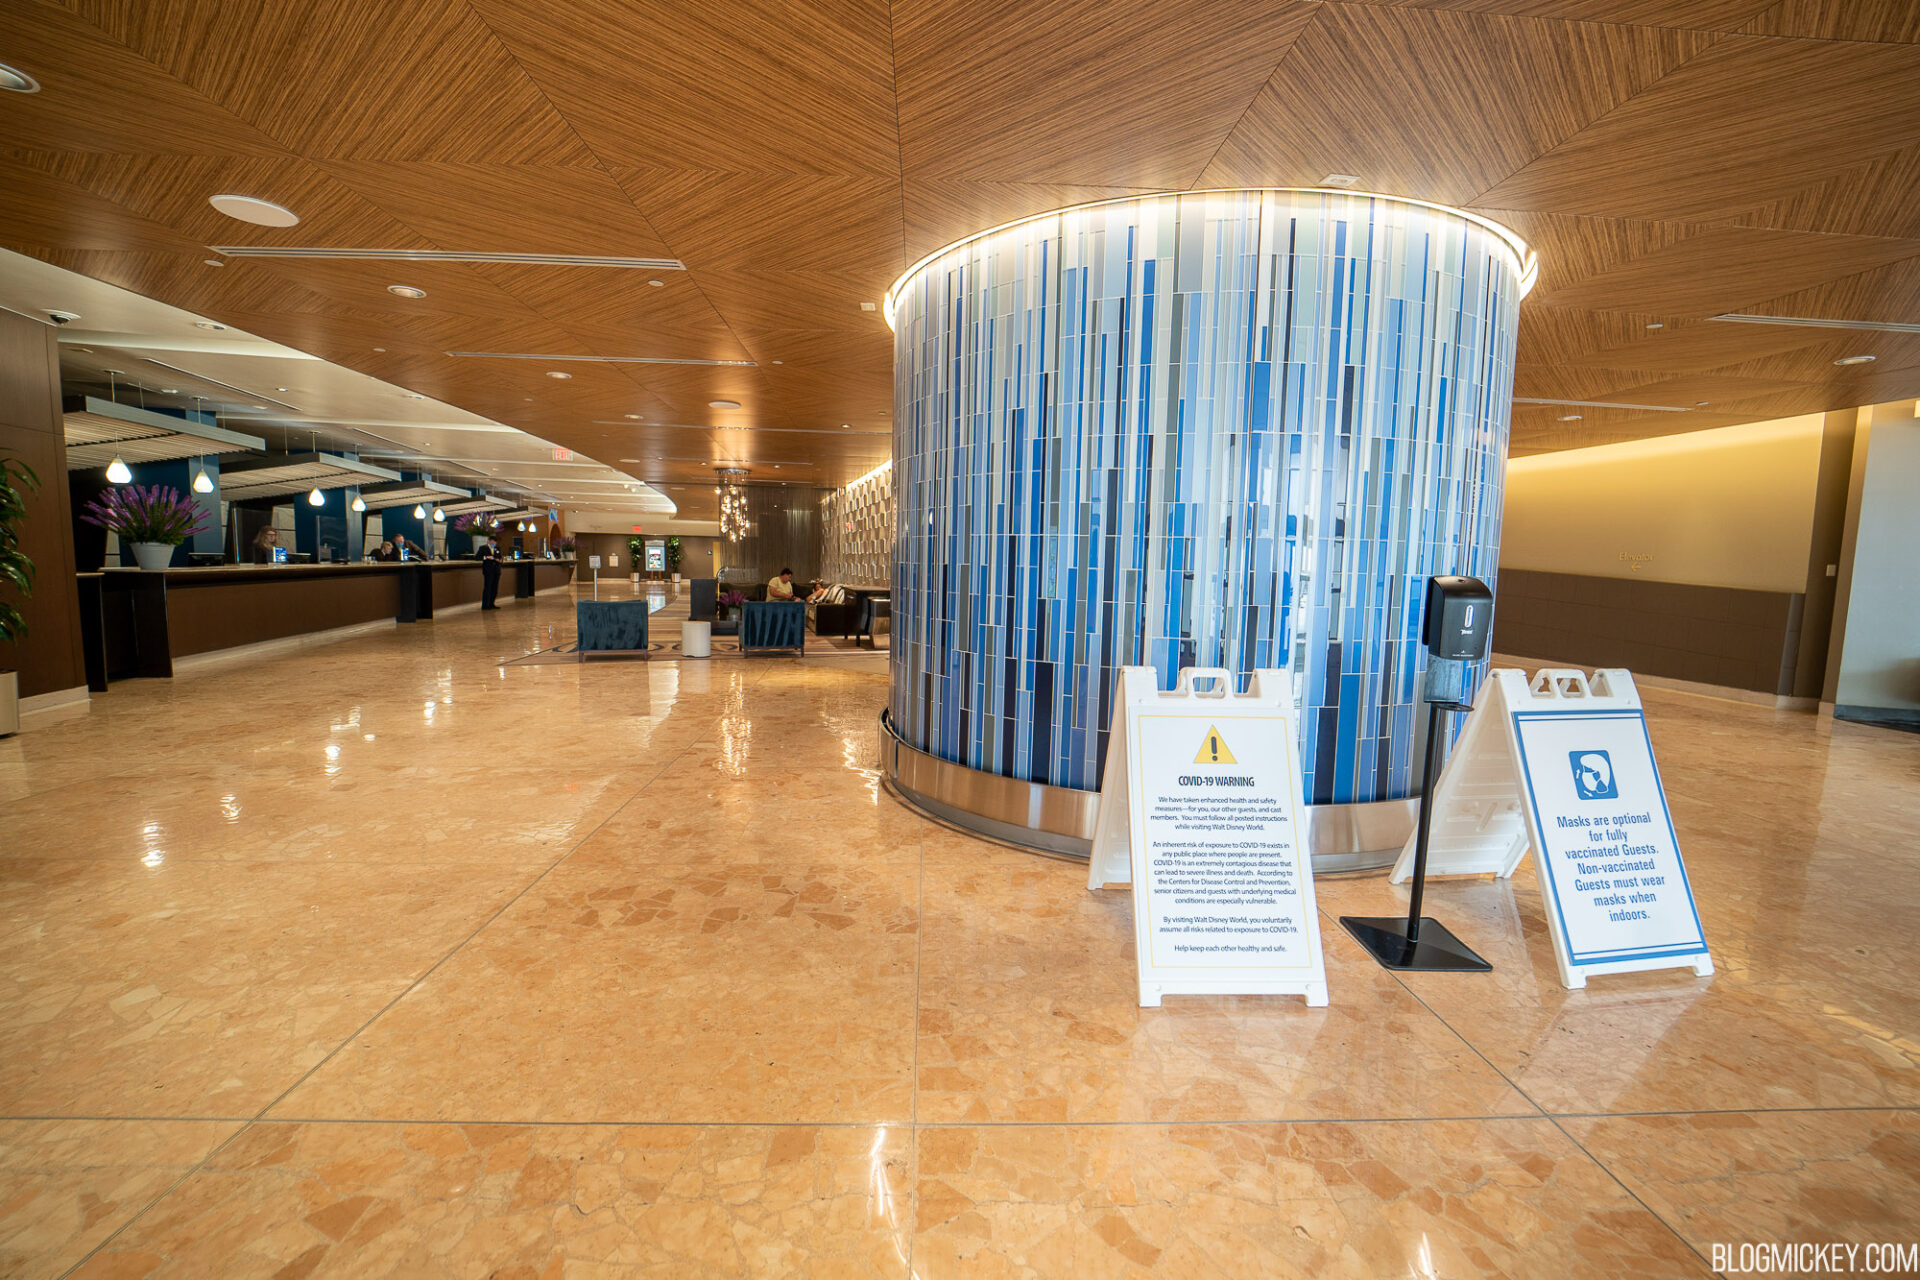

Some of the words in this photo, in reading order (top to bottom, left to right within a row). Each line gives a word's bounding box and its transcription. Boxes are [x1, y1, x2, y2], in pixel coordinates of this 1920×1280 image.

[1178, 776, 1214, 786] COVID-19
[1215, 776, 1255, 787] WARNING
[1557, 816, 1591, 828] Masks
[1594, 817, 1610, 826] are
[1612, 812, 1652, 827] optional
[1589, 830, 1603, 842] for
[1606, 829, 1628, 842] fully
[1565, 845, 1620, 859] vaccinated
[1622, 844, 1659, 856] Guests.
[1577, 858, 1656, 875] Non-vaccinated
[1257, 870, 1286, 878] According
[1575, 879, 1611, 892] Guests
[1613, 877, 1639, 888] must
[1641, 876, 1665, 886] wear
[1594, 893, 1627, 906] masks
[1629, 892, 1657, 904] when
[1163, 916, 1172, 924] By
[1609, 909, 1650, 922] indoors.
